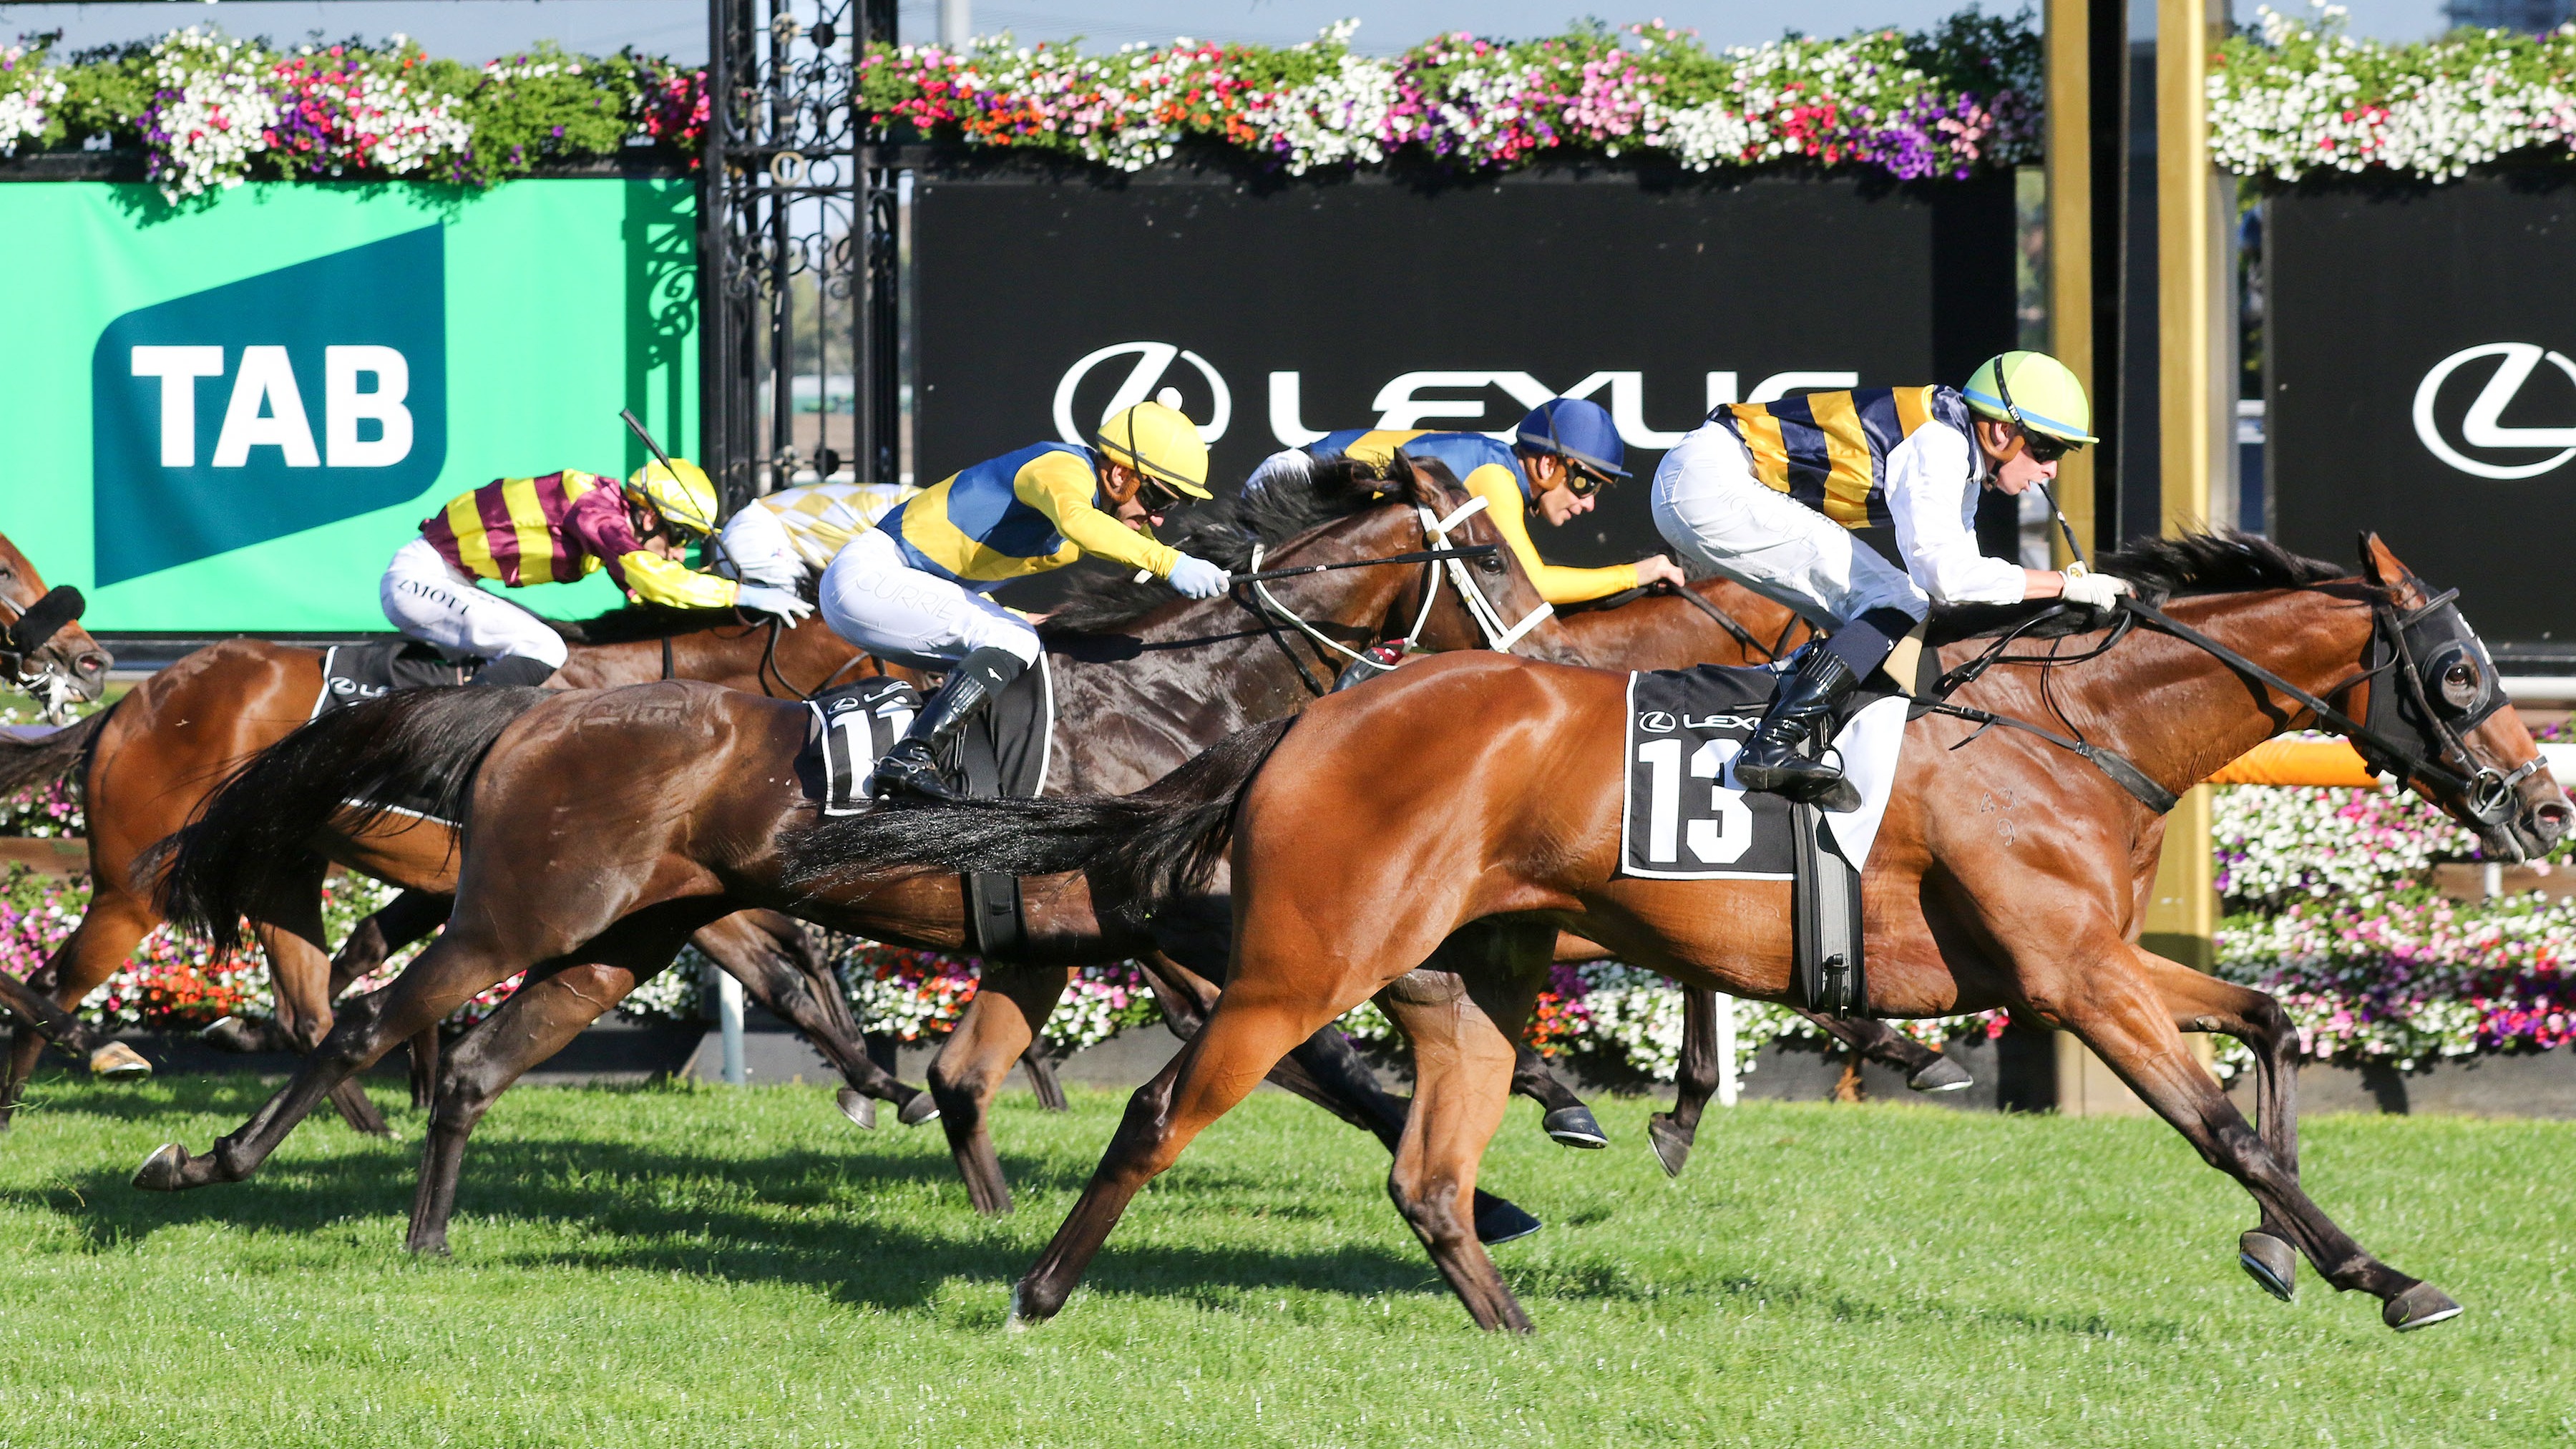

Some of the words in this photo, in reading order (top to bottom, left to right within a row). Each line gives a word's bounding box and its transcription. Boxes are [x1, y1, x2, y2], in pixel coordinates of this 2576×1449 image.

[131, 345, 414, 467] TAB
[856, 571, 965, 620] CURRIE
[1682, 714, 1762, 731] LEX
[1638, 737, 1753, 864] 13
